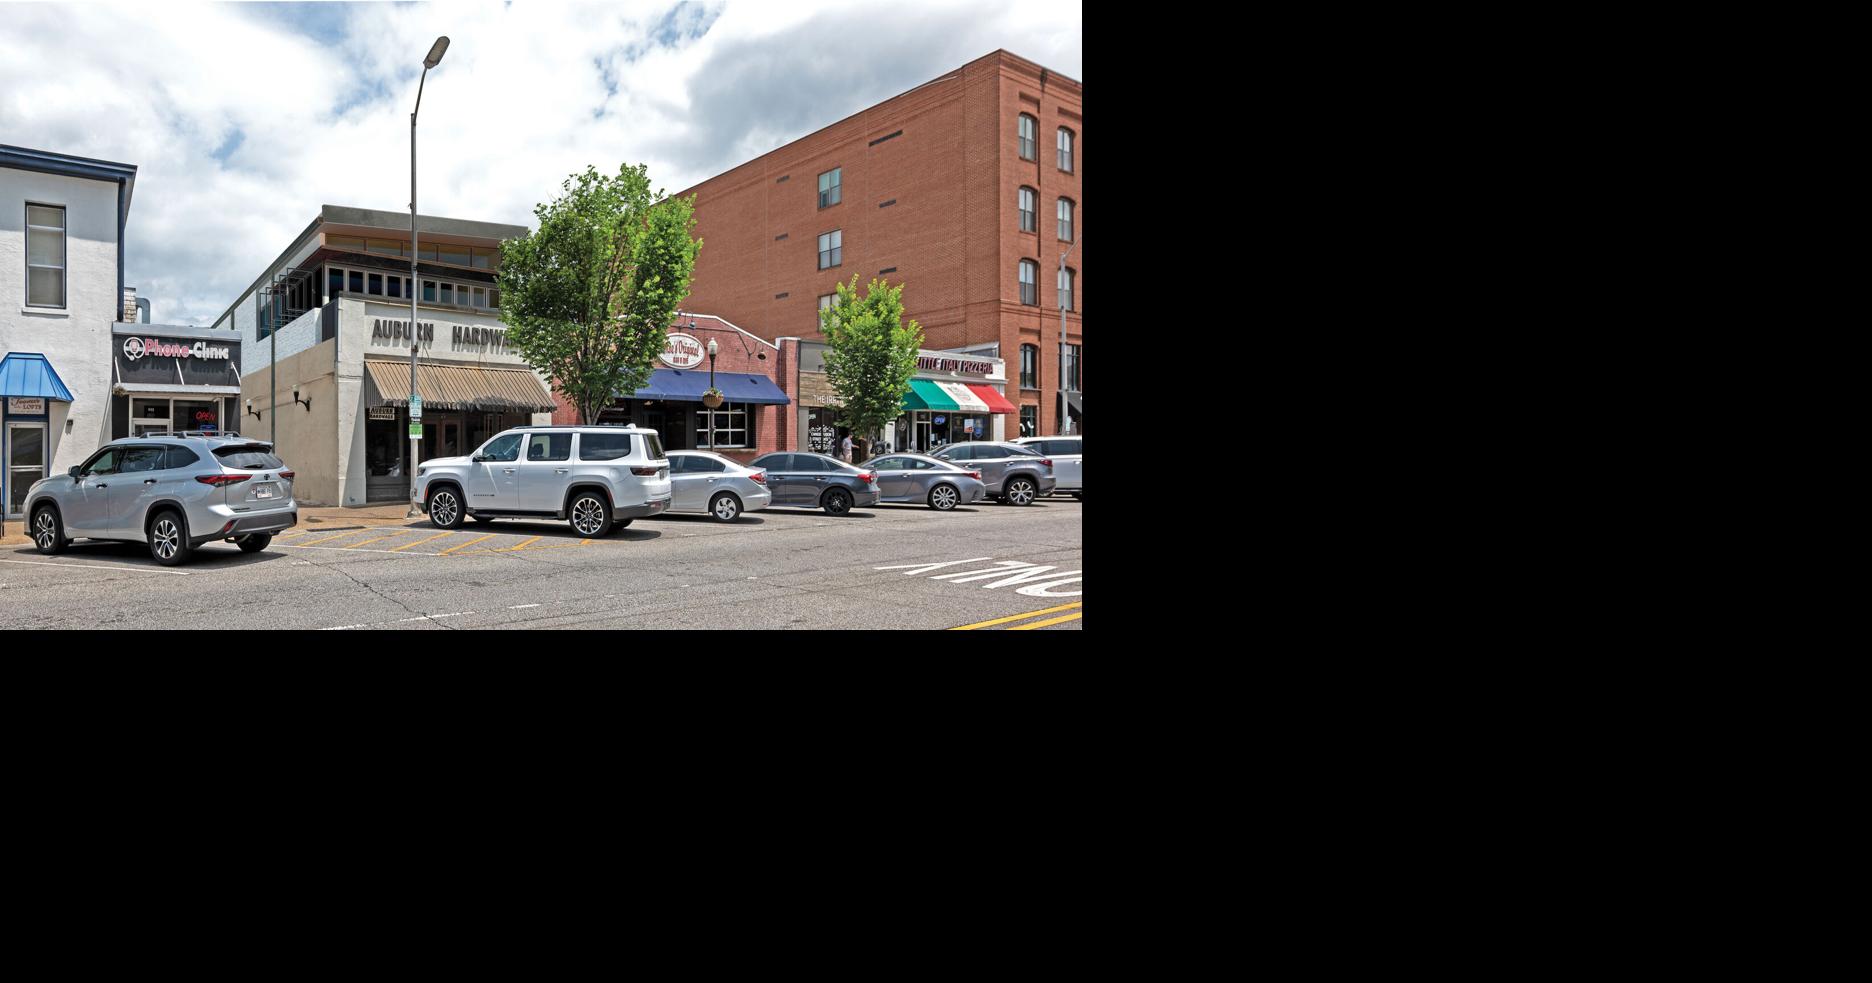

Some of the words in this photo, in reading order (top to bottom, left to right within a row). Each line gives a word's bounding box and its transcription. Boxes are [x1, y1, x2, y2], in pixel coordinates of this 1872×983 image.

[372, 319, 434, 342] AUBURN
[452, 325, 515, 347] HARDWA
[144, 338, 190, 358] Phone
[193, 341, 229, 360] Clinic
[915, 357, 941, 370] LITTLE
[942, 359, 962, 372] ITALY
[963, 360, 994, 375] PIZZERIA
[195, 411, 216, 421] OPEN
